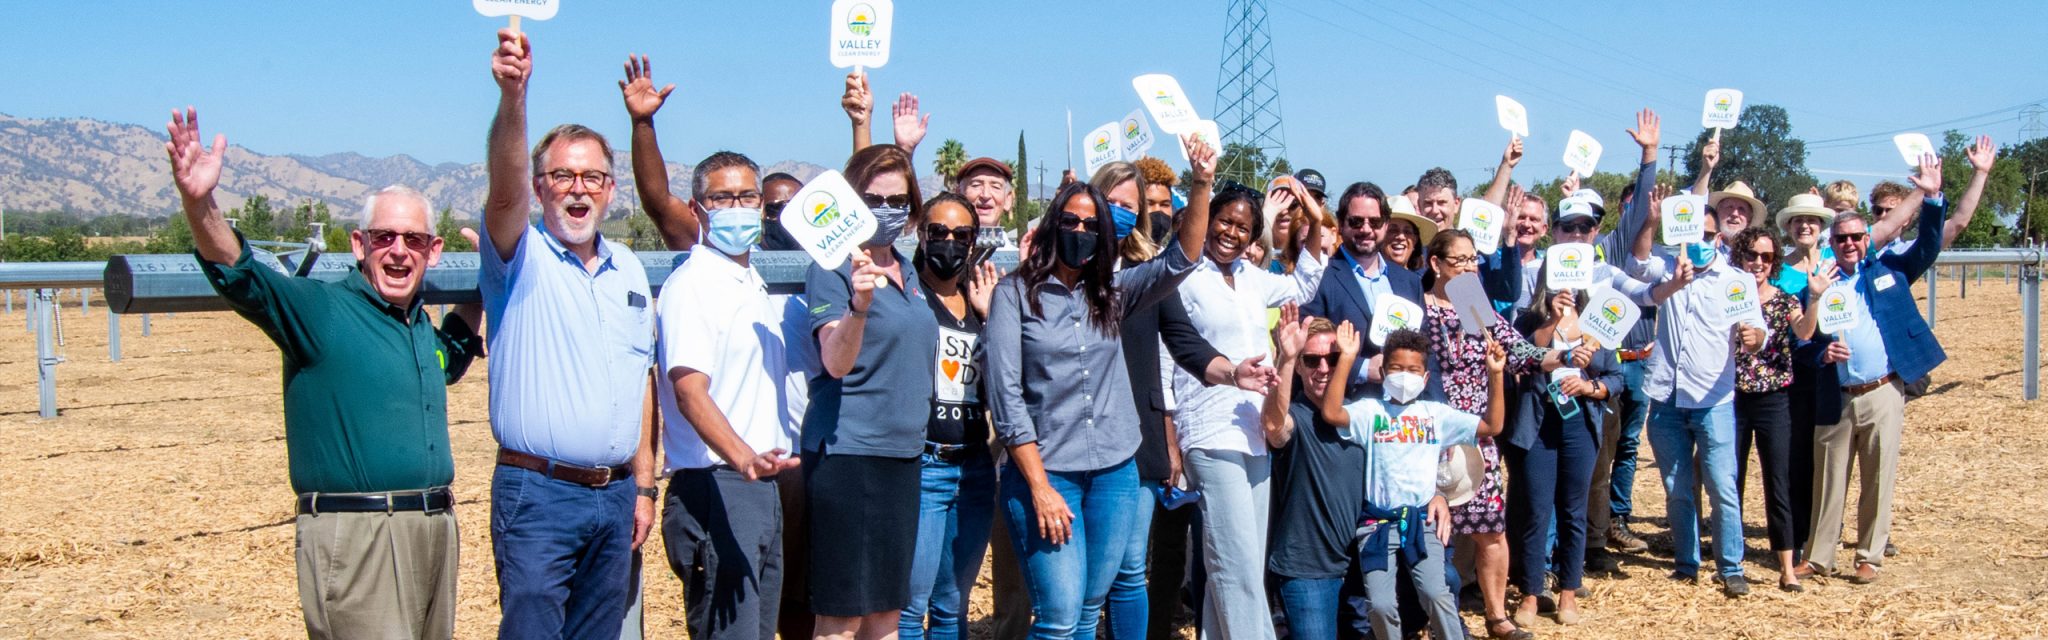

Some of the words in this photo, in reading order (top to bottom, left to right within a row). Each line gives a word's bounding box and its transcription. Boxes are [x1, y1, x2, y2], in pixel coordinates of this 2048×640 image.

[839, 39, 881, 49] VALLEY
[816, 209, 859, 250] VALLEY
[1669, 224, 1699, 233] VALLEY
[825, 240, 844, 258] CLEAN
[844, 219, 866, 241] ENERGY
[1553, 270, 1586, 278] VALLEY
[1723, 300, 1754, 314] VALLEY
[1824, 312, 1853, 322] VALLEY
[1589, 312, 1620, 337] VALLEY
